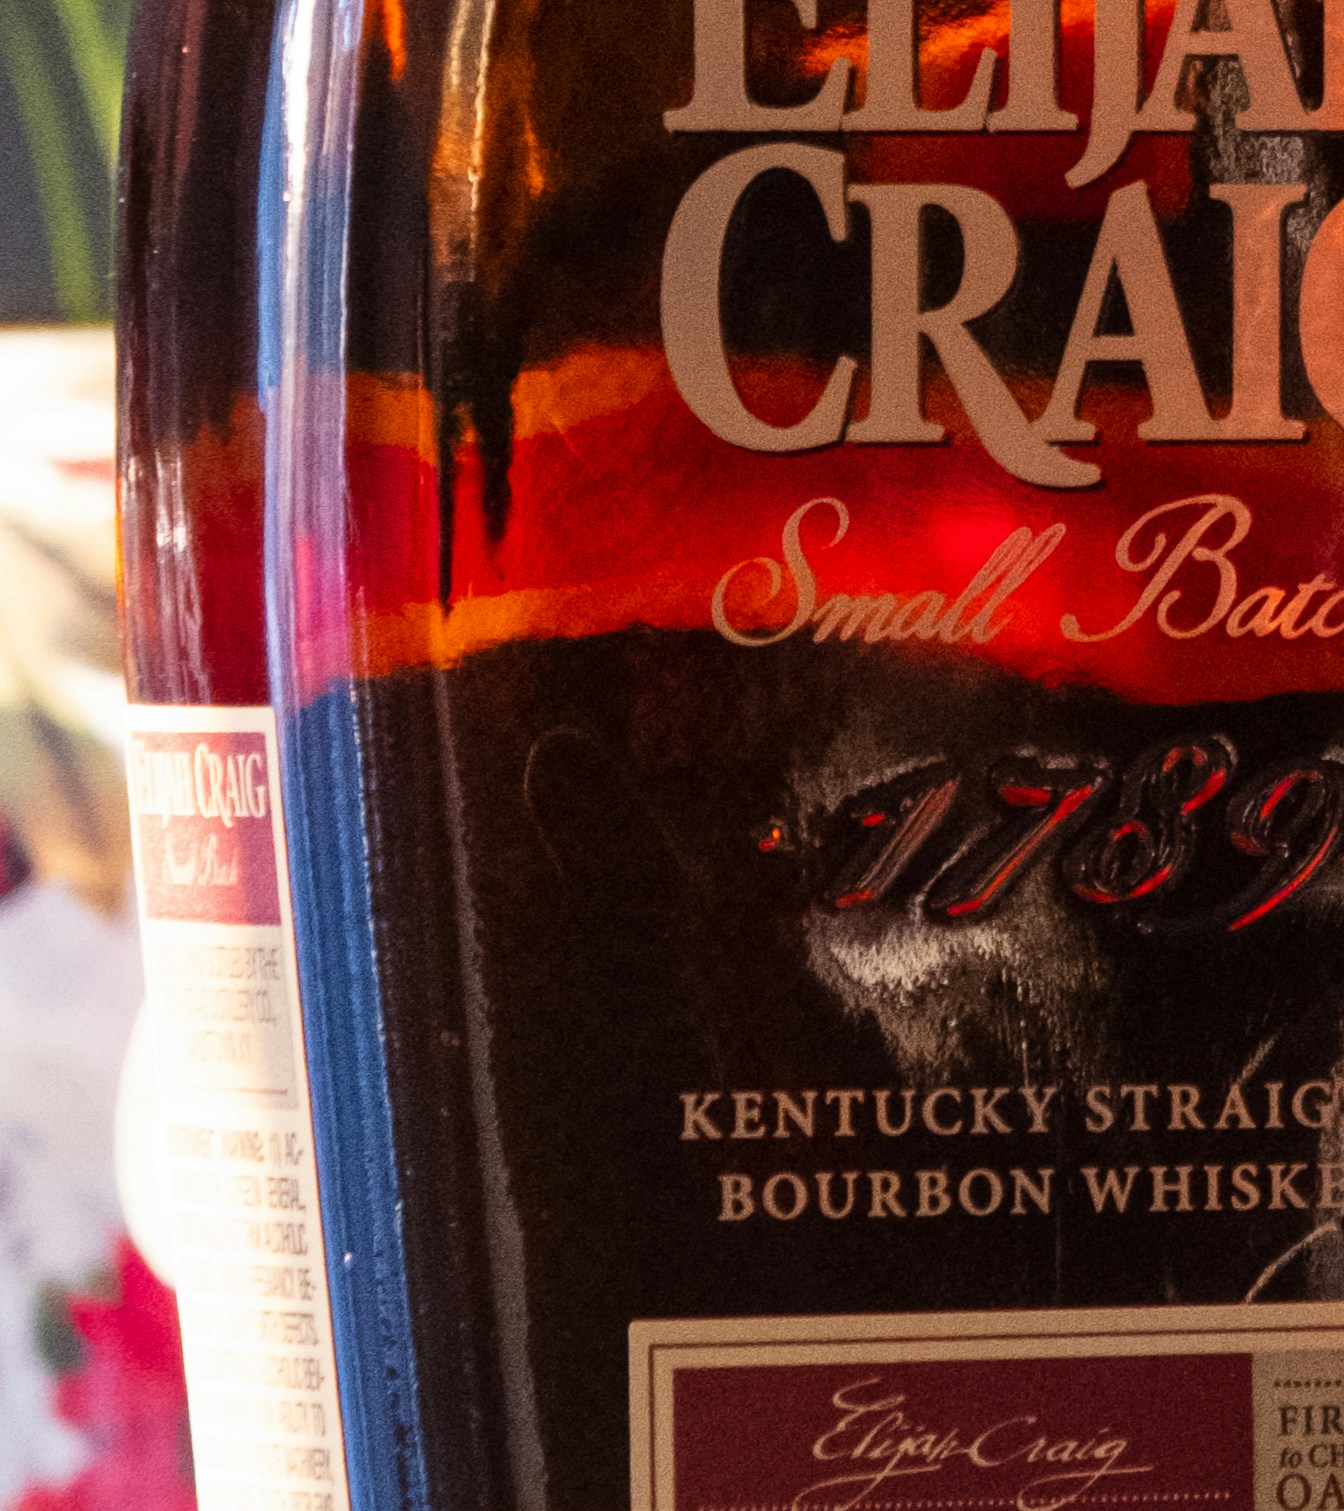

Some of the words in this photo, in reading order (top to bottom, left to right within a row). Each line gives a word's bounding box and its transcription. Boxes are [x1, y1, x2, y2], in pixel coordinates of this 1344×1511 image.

[711, 496, 1067, 647] Small
[194, 740, 267, 828] CRAIG
[679, 1087, 1057, 1140] KENTUCKY
[717, 1166, 1055, 1222] BOURBON
[966, 1416, 1154, 1511] Craig
[1278, 1442, 1302, 1469] to
